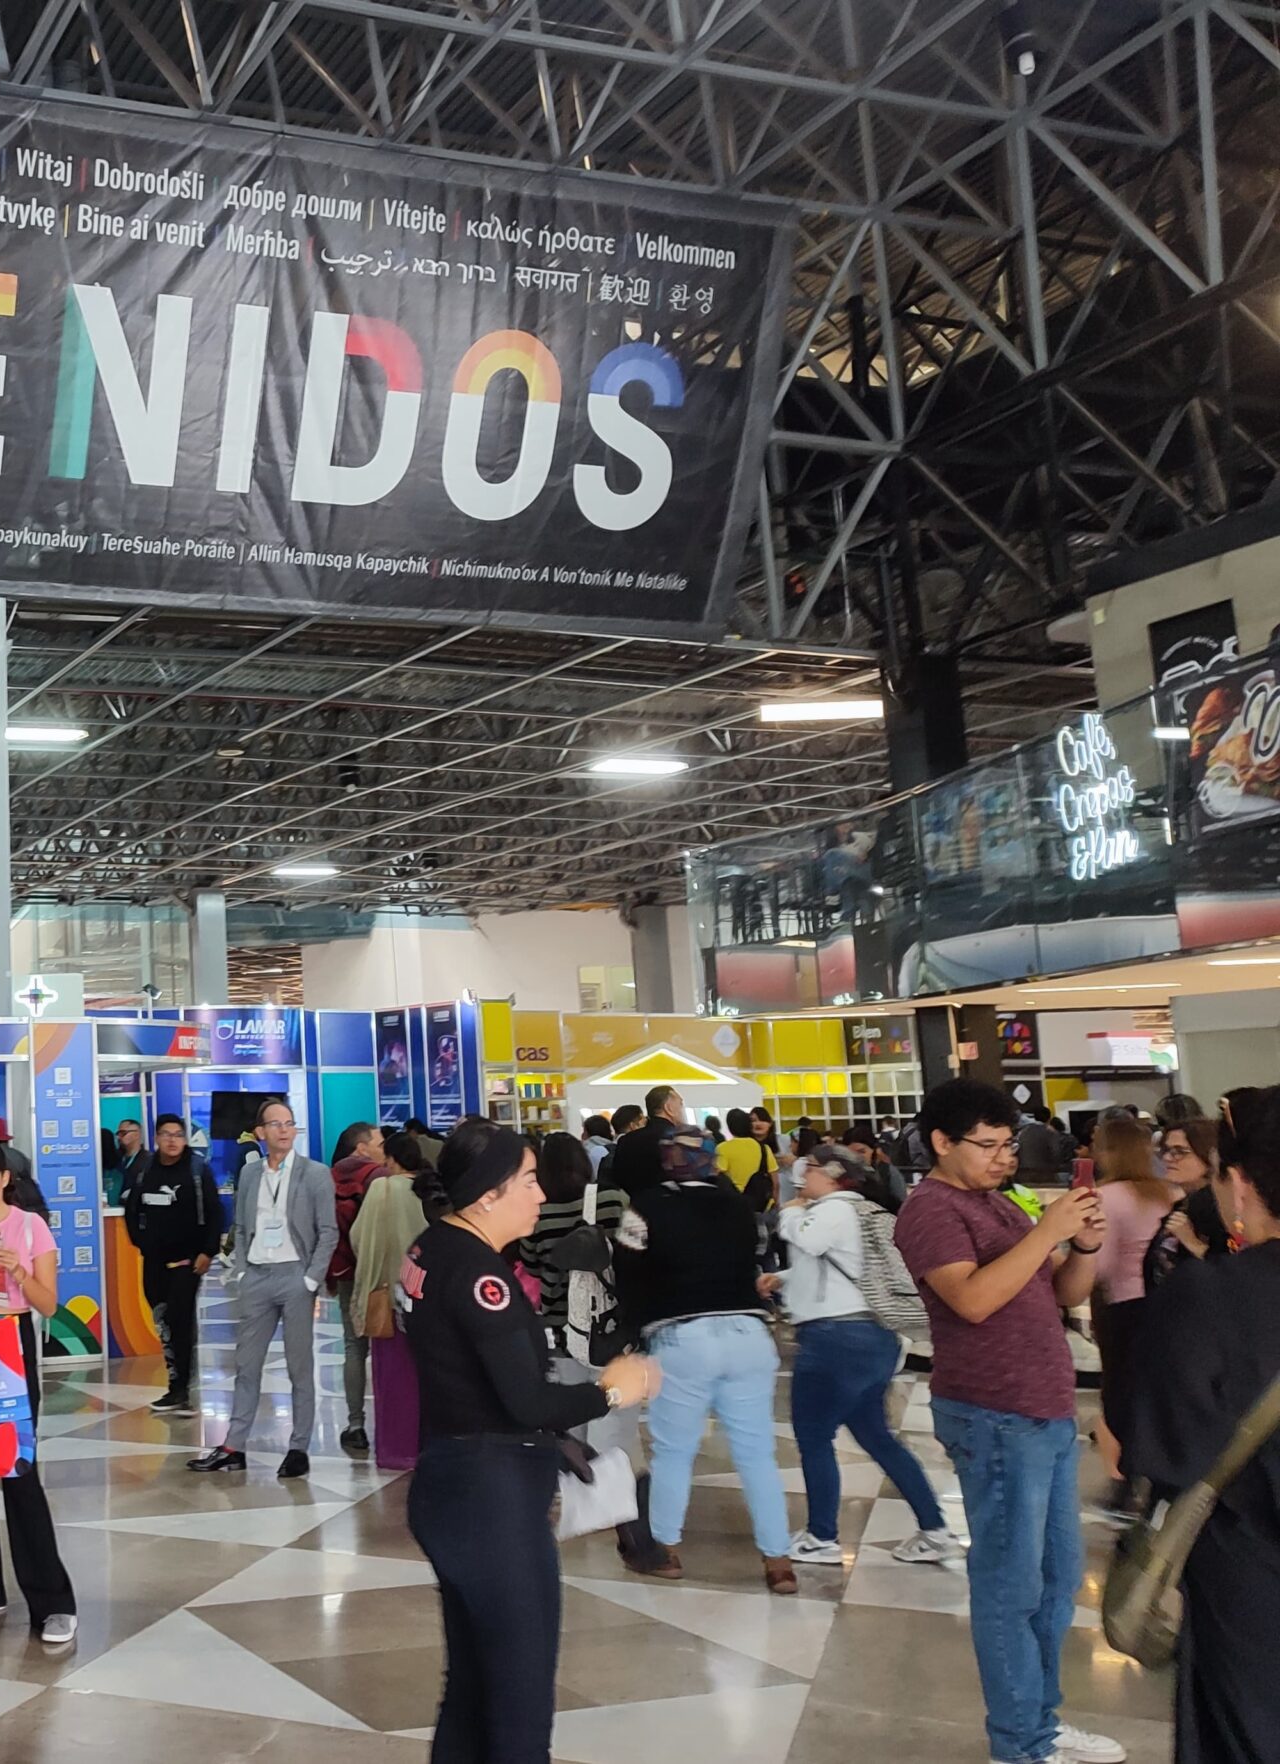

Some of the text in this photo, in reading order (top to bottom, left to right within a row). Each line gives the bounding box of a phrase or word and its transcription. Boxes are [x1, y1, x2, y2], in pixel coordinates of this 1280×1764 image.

[16, 147, 73, 187] Witaj
[94, 158, 206, 201] Dobrodošli
[223, 180, 362, 222] добре дошли
[383, 198, 447, 233] Vítejte
[77, 204, 124, 237] Bine
[129, 214, 149, 240] ai
[155, 219, 206, 248] venit
[636, 232, 735, 270] Velkommen
[247, 544, 281, 563] Allin
[284, 547, 352, 571] Hamusqa
[355, 552, 429, 577] Kapaychik
[539, 566, 550, 582] A
[613, 570, 634, 588] Me
[635, 572, 688, 591] Natalike
[235, 1020, 286, 1034] LAMAR
